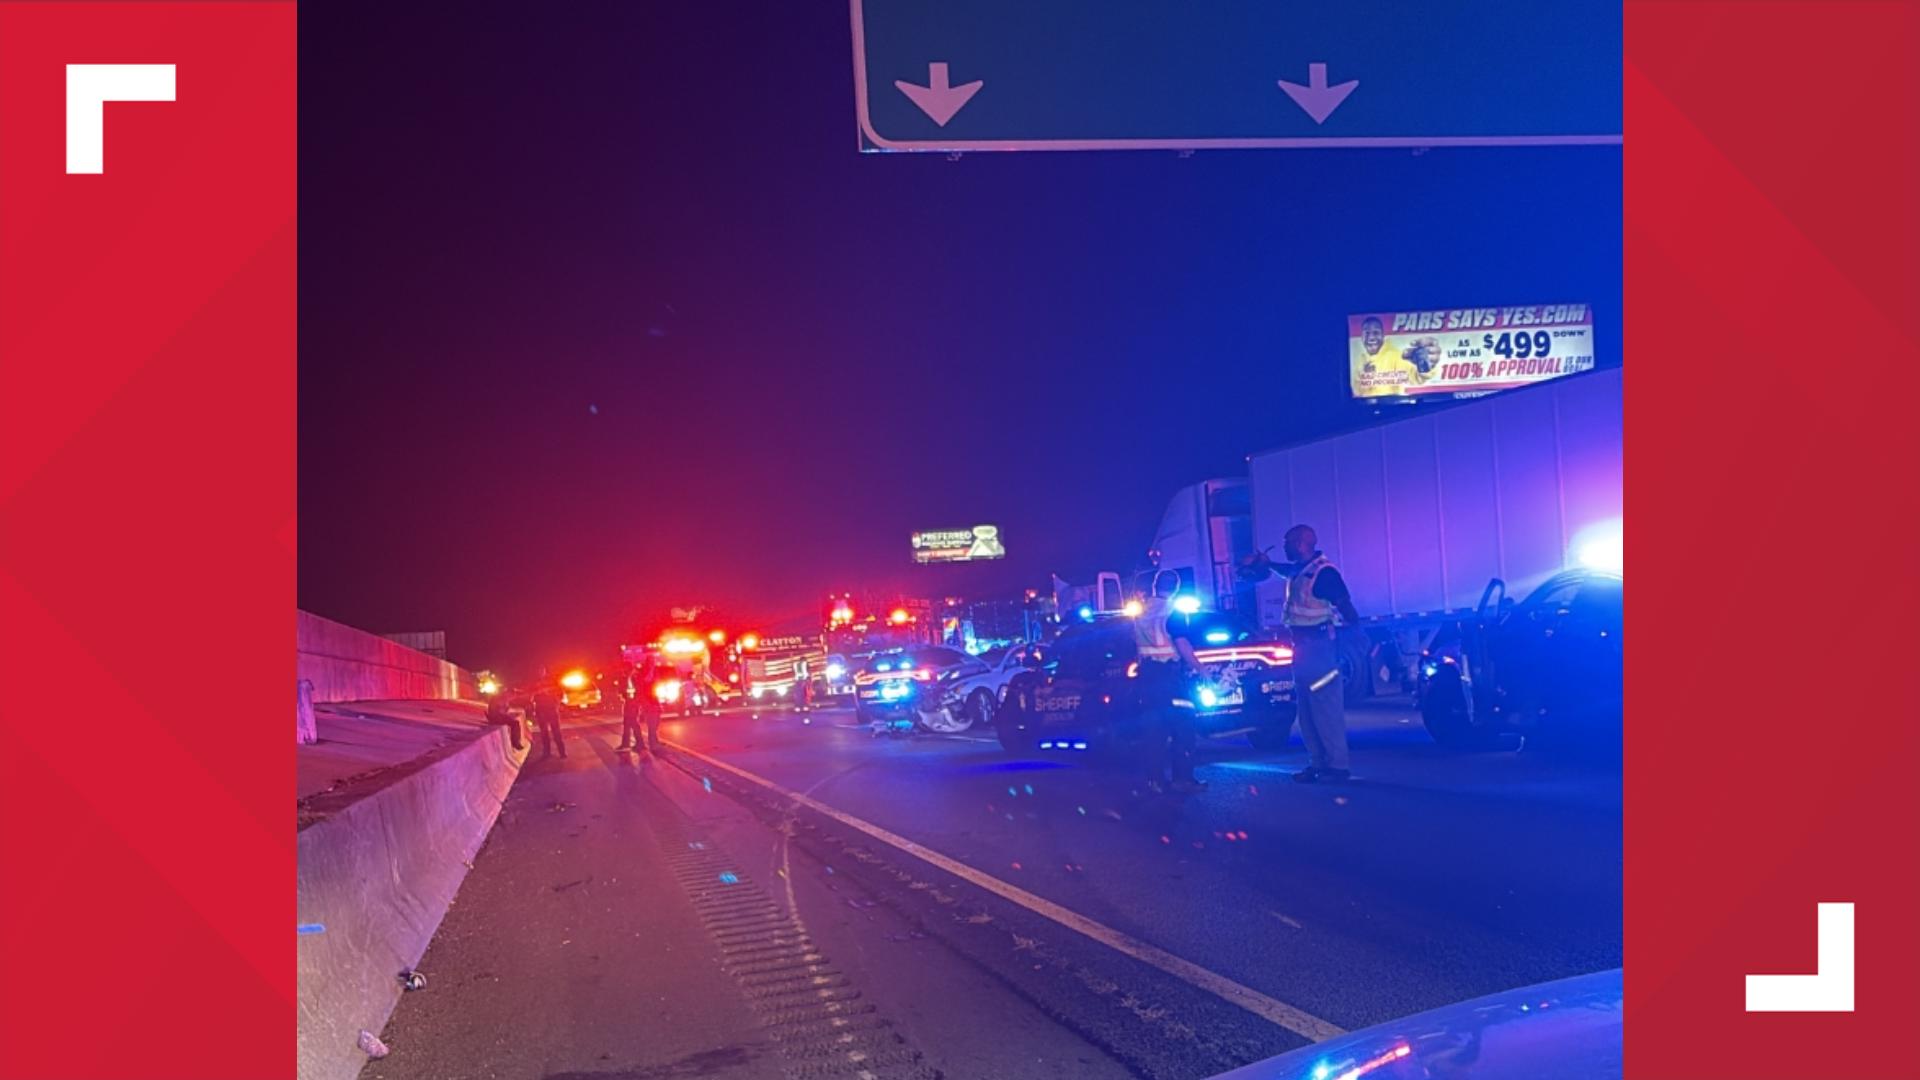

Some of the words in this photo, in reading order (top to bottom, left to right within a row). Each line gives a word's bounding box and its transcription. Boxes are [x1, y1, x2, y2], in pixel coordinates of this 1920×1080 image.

[1392, 311, 1444, 331] PARS
[1447, 308, 1494, 329] SAYS
[1500, 304, 1587, 326] YES.COM
[1457, 339, 1470, 347] AS
[1483, 330, 1551, 359] $499
[1447, 349, 1467, 358] LOW
[1469, 348, 1481, 357] AS
[1440, 362, 1484, 380] 100%
[1486, 357, 1562, 377] APPROVAL
[760, 636, 802, 646] CLAYTON
[1034, 695, 1082, 711] SHERIFF
